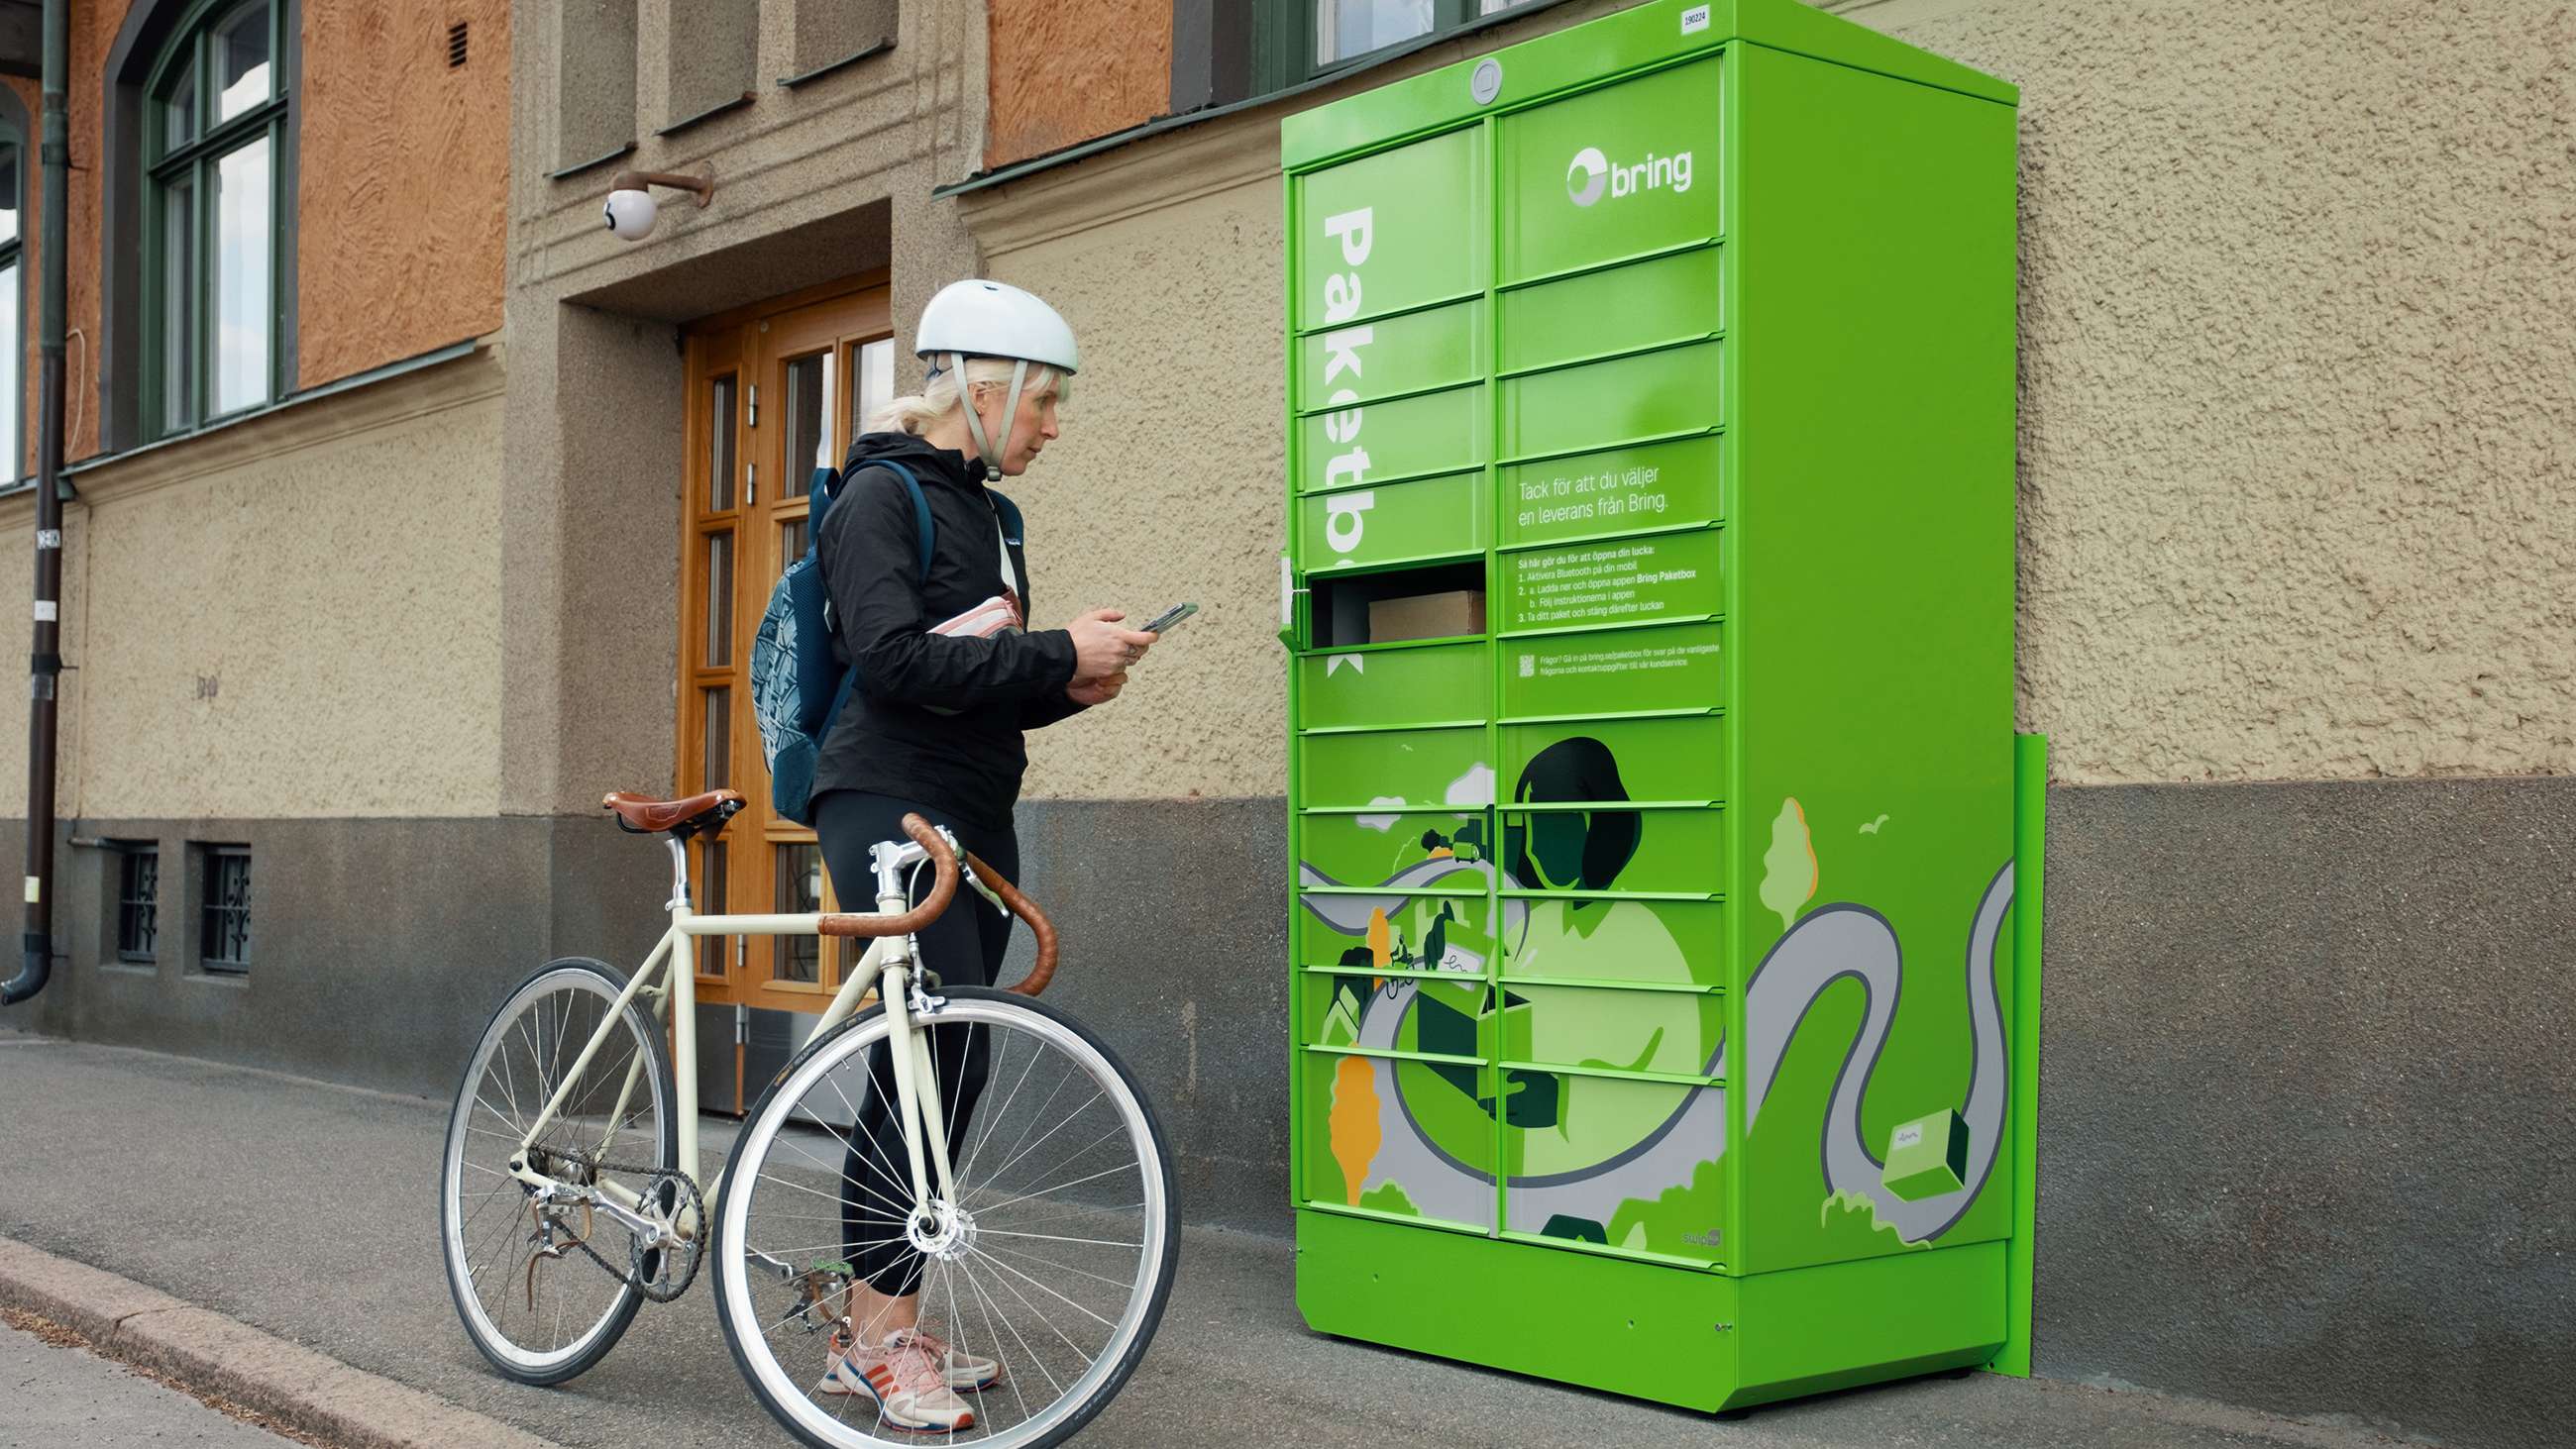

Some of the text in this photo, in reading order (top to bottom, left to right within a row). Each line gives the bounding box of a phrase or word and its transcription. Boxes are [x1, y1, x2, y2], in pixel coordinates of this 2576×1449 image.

[1612, 152, 1692, 198] bring
[1325, 206, 1375, 678] Paketb
[1519, 467, 1660, 500] Tack för att du väljer
[1518, 493, 1668, 527] en leverans från Bring.
[1542, 557, 1555, 569] gör
[1556, 555, 1566, 565] du
[1567, 554, 1578, 564] för
[1580, 553, 1591, 562] att
[1592, 551, 1617, 562] öppna
[1618, 547, 1631, 558] din
[1556, 568, 1591, 578] Bluetooth
[1593, 567, 1602, 576] på
[1604, 564, 1615, 573] din
[1616, 561, 1638, 571] mobil
[1537, 583, 1558, 594] Ladda
[1572, 580, 1586, 590] och
[1588, 579, 1611, 589] öppna
[1612, 576, 1636, 587] appen
[1637, 573, 1658, 584] Bring
[1660, 569, 1697, 581] Paketbox
[1528, 612, 1536, 622] Ta
[1537, 611, 1550, 621] ditt
[1551, 610, 1570, 621] paket
[1571, 608, 1586, 618] och
[1586, 606, 1608, 617] stäng
[1640, 601, 1664, 611] luckan
[1539, 597, 1553, 609] Följ
[1611, 590, 1635, 601] appen
